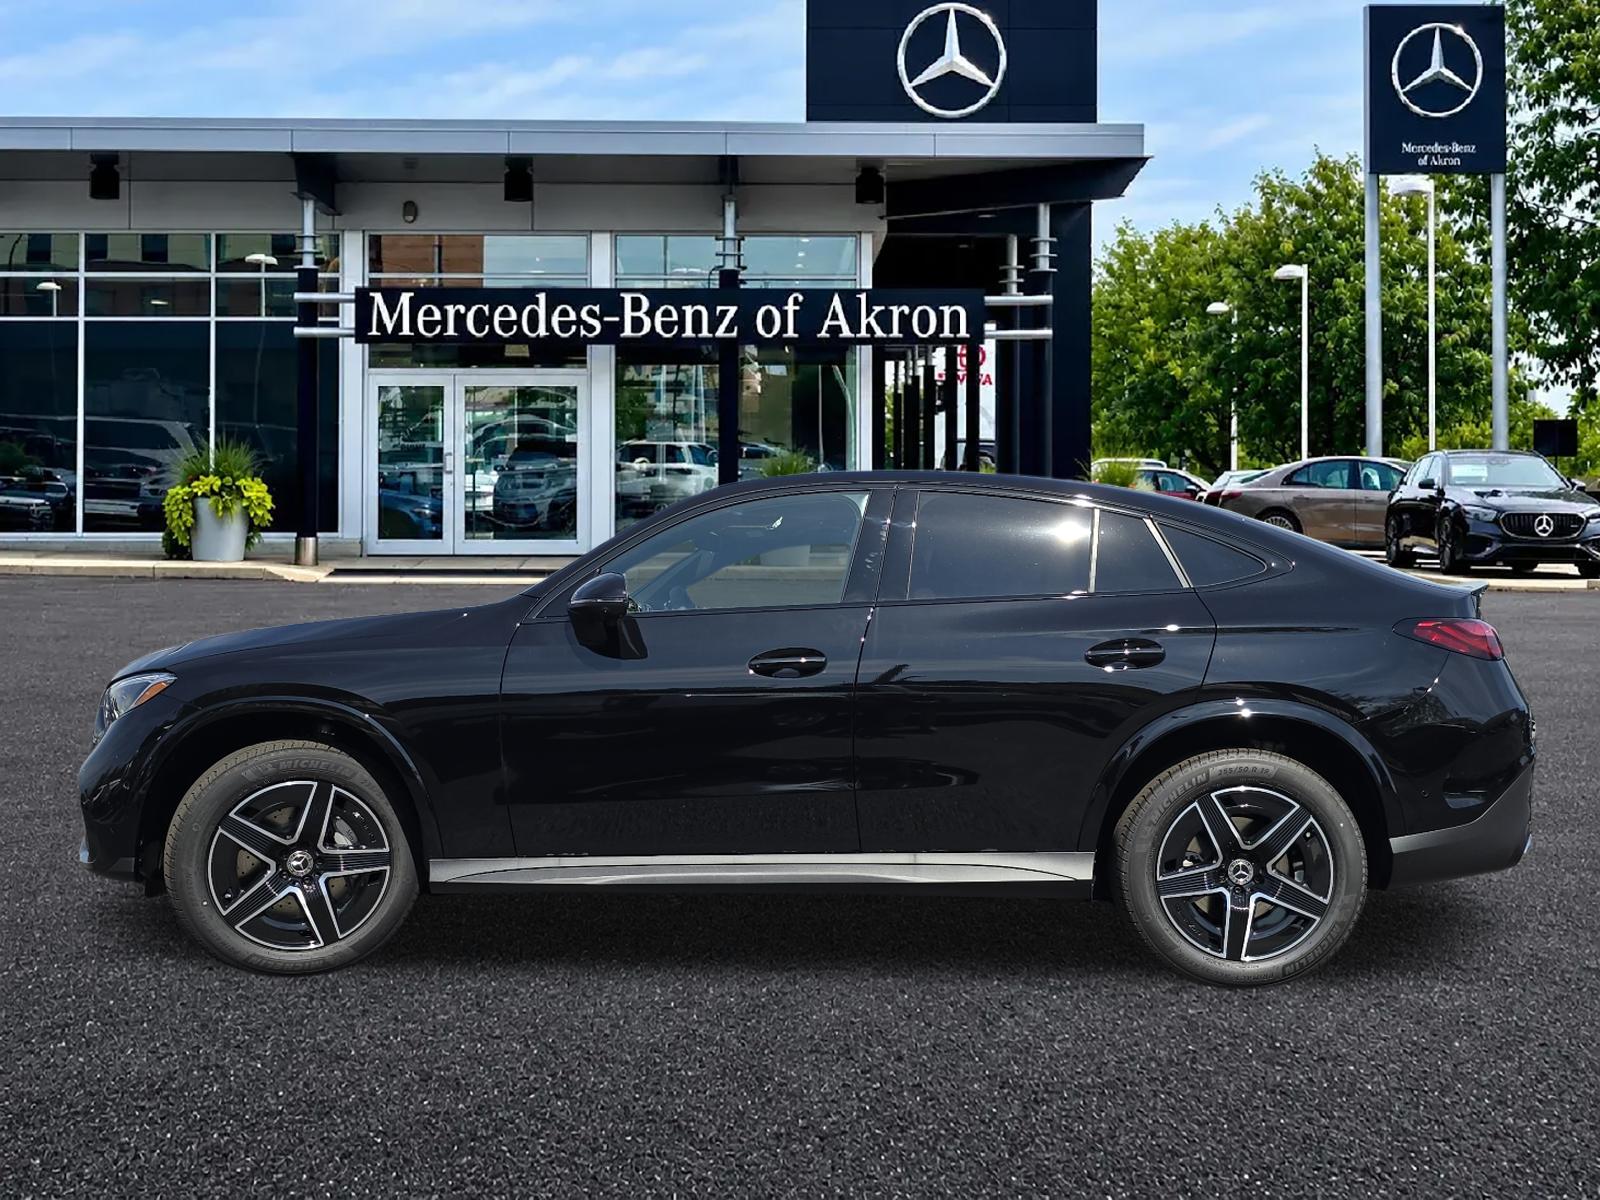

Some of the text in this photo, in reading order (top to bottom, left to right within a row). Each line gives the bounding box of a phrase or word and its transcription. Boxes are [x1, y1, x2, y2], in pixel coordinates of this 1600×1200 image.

[1401, 142, 1476, 153] Mercedes-Benz
[1417, 155, 1461, 166] of Akron
[367, 292, 970, 339] Mercedes-Benz of Akron
[1151, 773, 1207, 825] MICHELIN
